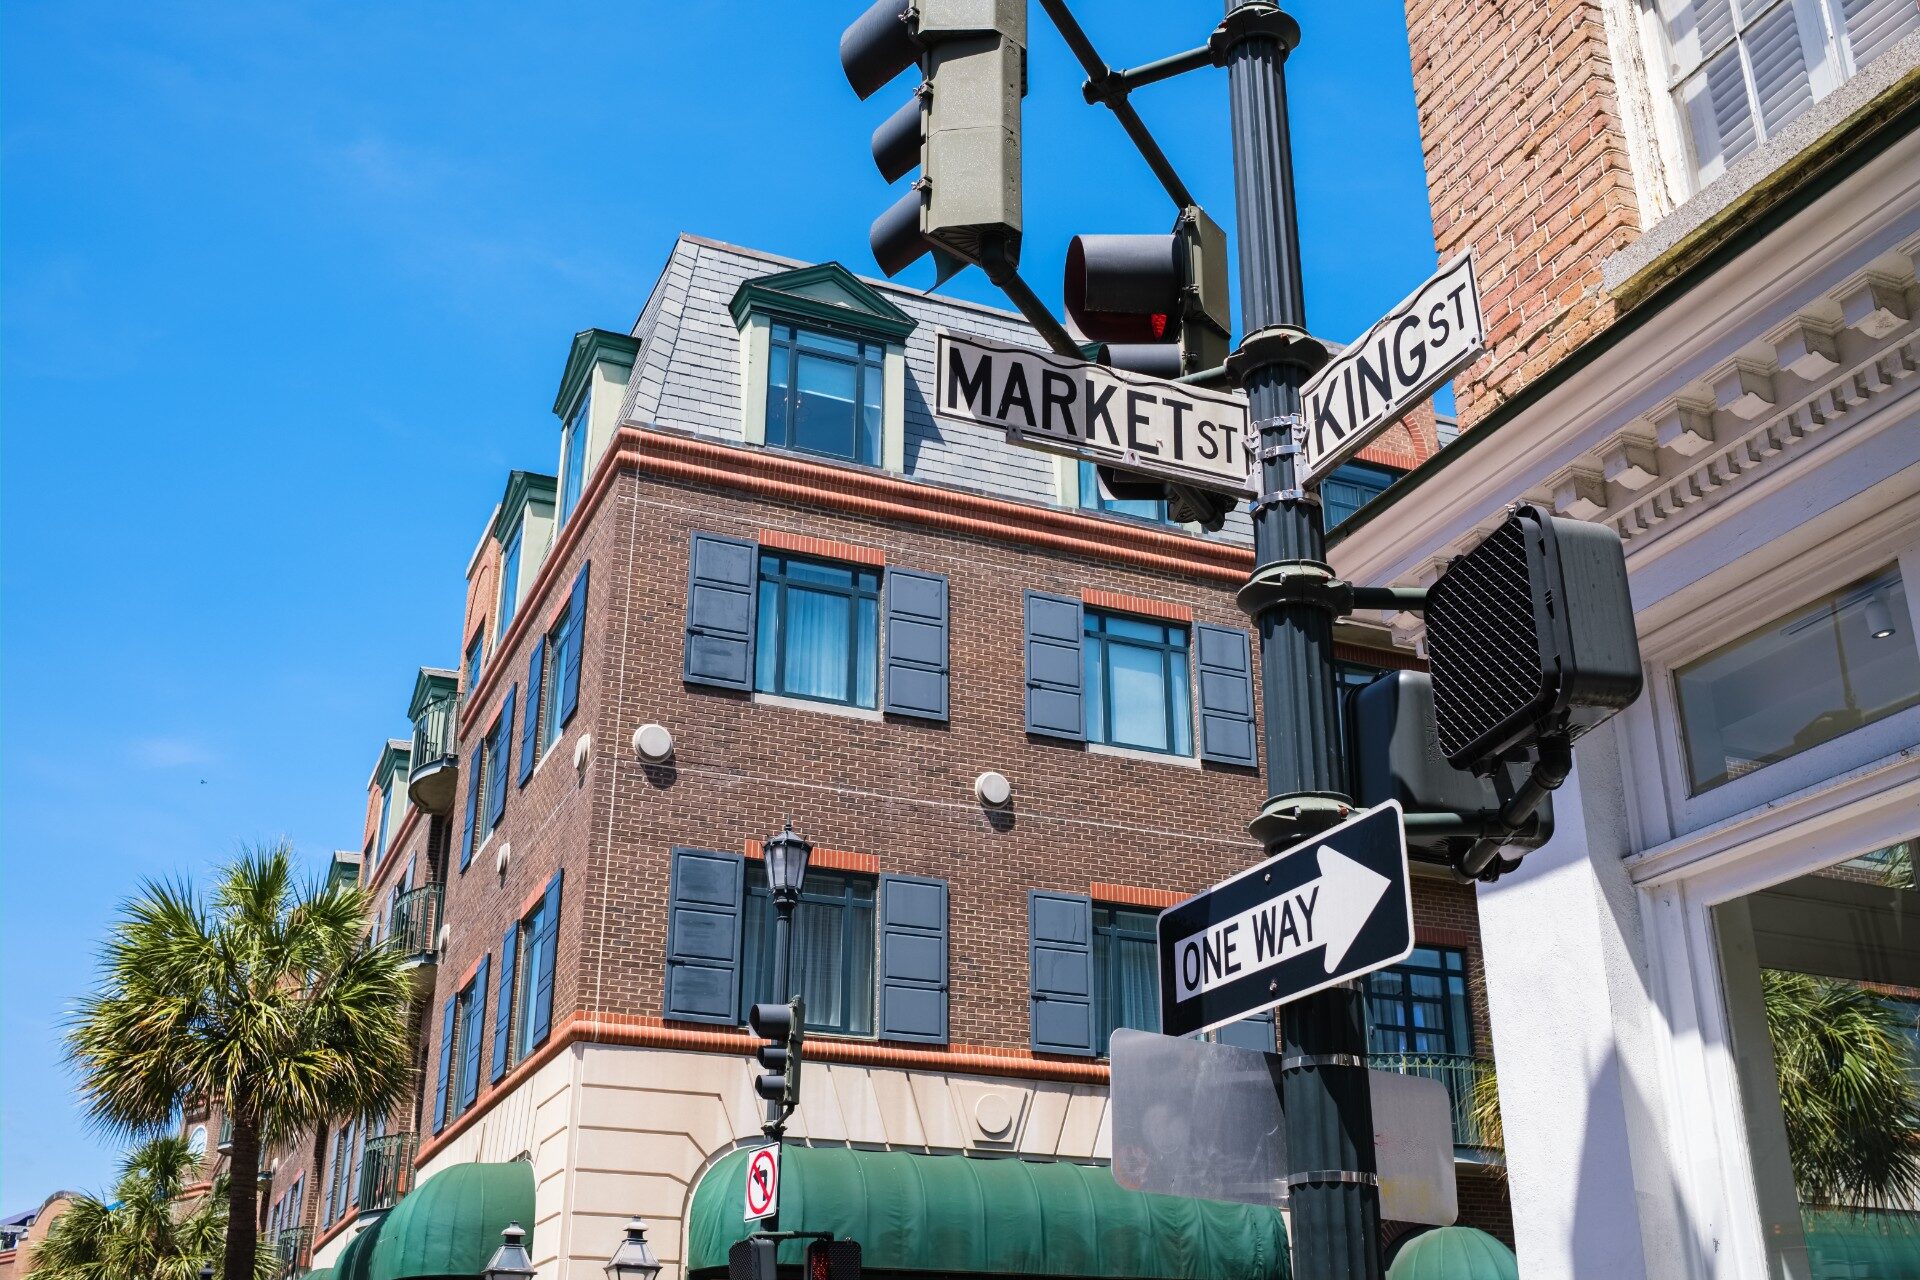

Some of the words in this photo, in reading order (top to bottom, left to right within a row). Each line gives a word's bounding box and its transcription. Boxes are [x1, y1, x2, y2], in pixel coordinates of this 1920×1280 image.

[948, 347, 1193, 461] MARKET
[1197, 421, 1238, 463] ST
[1311, 315, 1427, 456] KING
[1428, 282, 1467, 348] ST
[1184, 923, 1242, 991] ONE
[1252, 886, 1320, 963] WAY
